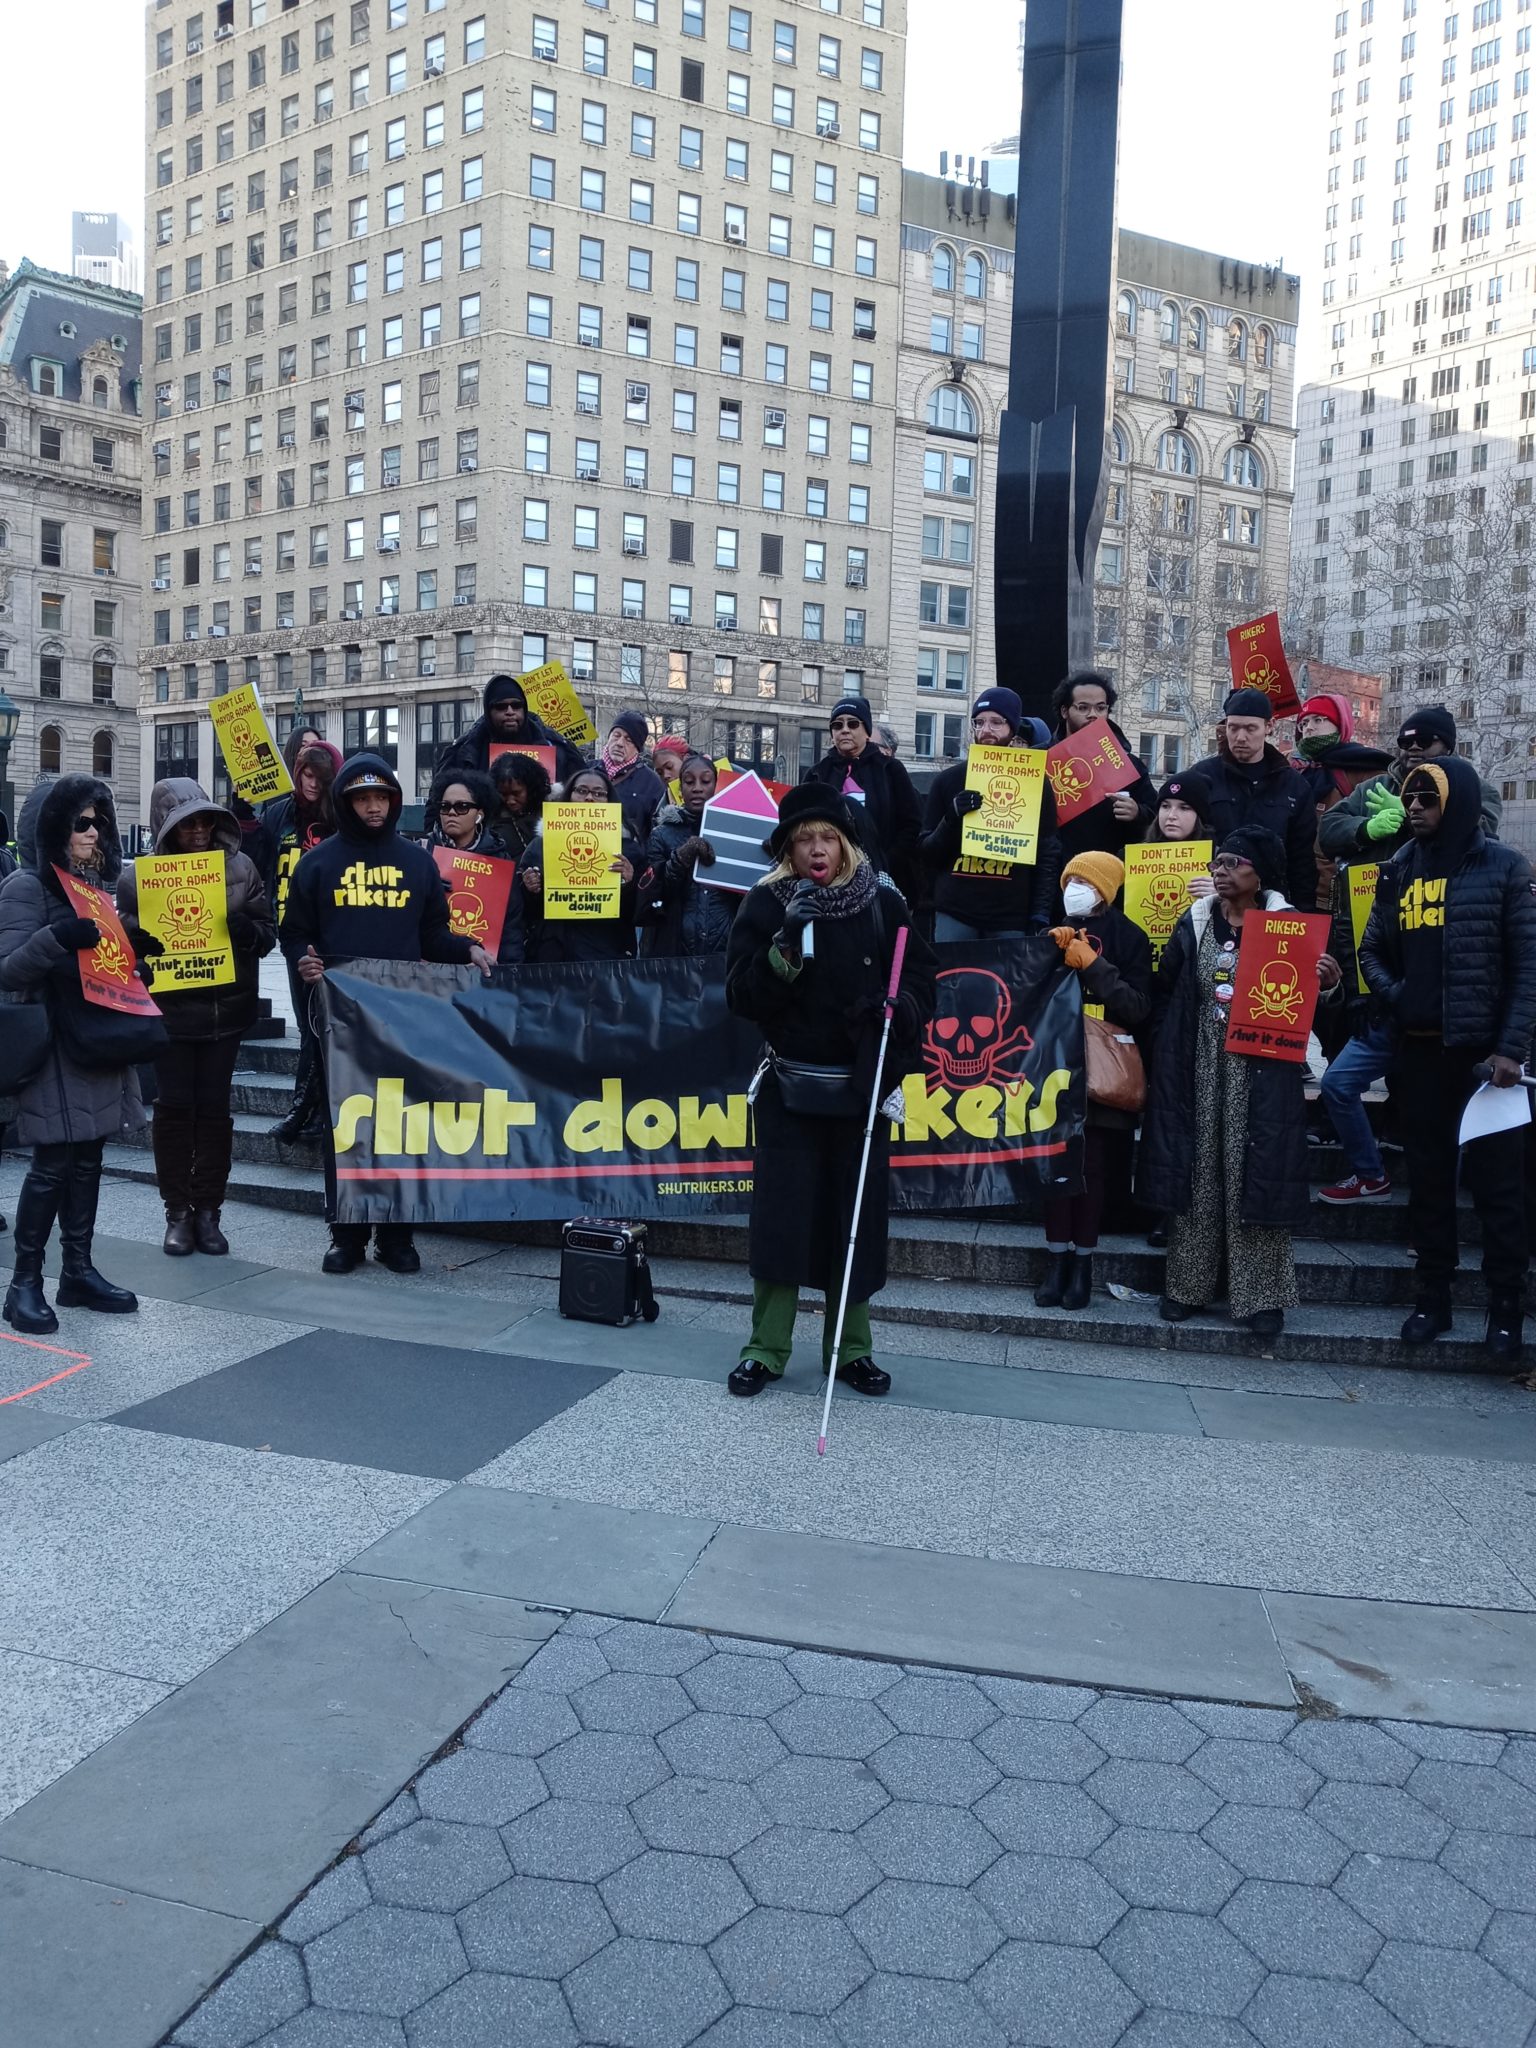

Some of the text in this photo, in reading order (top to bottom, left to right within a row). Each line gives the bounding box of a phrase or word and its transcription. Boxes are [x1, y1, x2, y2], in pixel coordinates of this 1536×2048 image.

[1240, 622, 1266, 642] RIKERS
[1250, 641, 1258, 651] IS
[523, 667, 553, 686] DON'T LET
[523, 674, 564, 697] AYOR ADAMS
[217, 692, 246, 713] DON'T LET
[540, 692, 553, 702] KILL
[215, 702, 257, 727] MAYOR ADAMS
[232, 723, 246, 733] KILL
[983, 750, 1032, 764] DON'T LET
[1098, 736, 1125, 770] RIKERS
[241, 759, 260, 772] AGAIN
[1092, 754, 1105, 767] IS
[971, 763, 1041, 778] MAYOR ADAMS
[236, 768, 280, 792] hut rikers
[995, 780, 1013, 790] KILL
[557, 808, 607, 818] DON'T LET
[547, 821, 618, 831] MAYOR ADAMS
[985, 818, 1015, 830] AGAIN
[573, 836, 592, 846] KILL
[965, 830, 1030, 848] shut rikers
[984, 843, 1018, 858] down
[1141, 847, 1195, 860] DON'T LET
[154, 859, 209, 874] DON'T LET
[452, 857, 493, 876] RIKERS
[1129, 861, 1207, 875] MAYOR ADAMS
[142, 872, 221, 890] MAYOR ADAMS
[340, 861, 403, 887] shut
[568, 876, 598, 886] AGAIN
[1362, 870, 1379, 881] DON
[464, 875, 475, 889] IS
[1157, 879, 1177, 890] KILL
[333, 883, 411, 908] rikers
[547, 890, 613, 902] shut rikers
[1353, 885, 1377, 896] MAYO
[175, 893, 197, 904] KILL
[568, 901, 601, 914] down
[1265, 919, 1306, 936] RIKERS
[172, 938, 207, 950] AGAIN
[1277, 940, 1289, 955] IS
[151, 955, 226, 972] shut rikers
[174, 968, 215, 981] down
[1230, 1028, 1306, 1050] shut it down
[333, 1069, 1071, 1156] shut dow kers
[657, 1179, 755, 1196] SHUTRIKERS.OR
